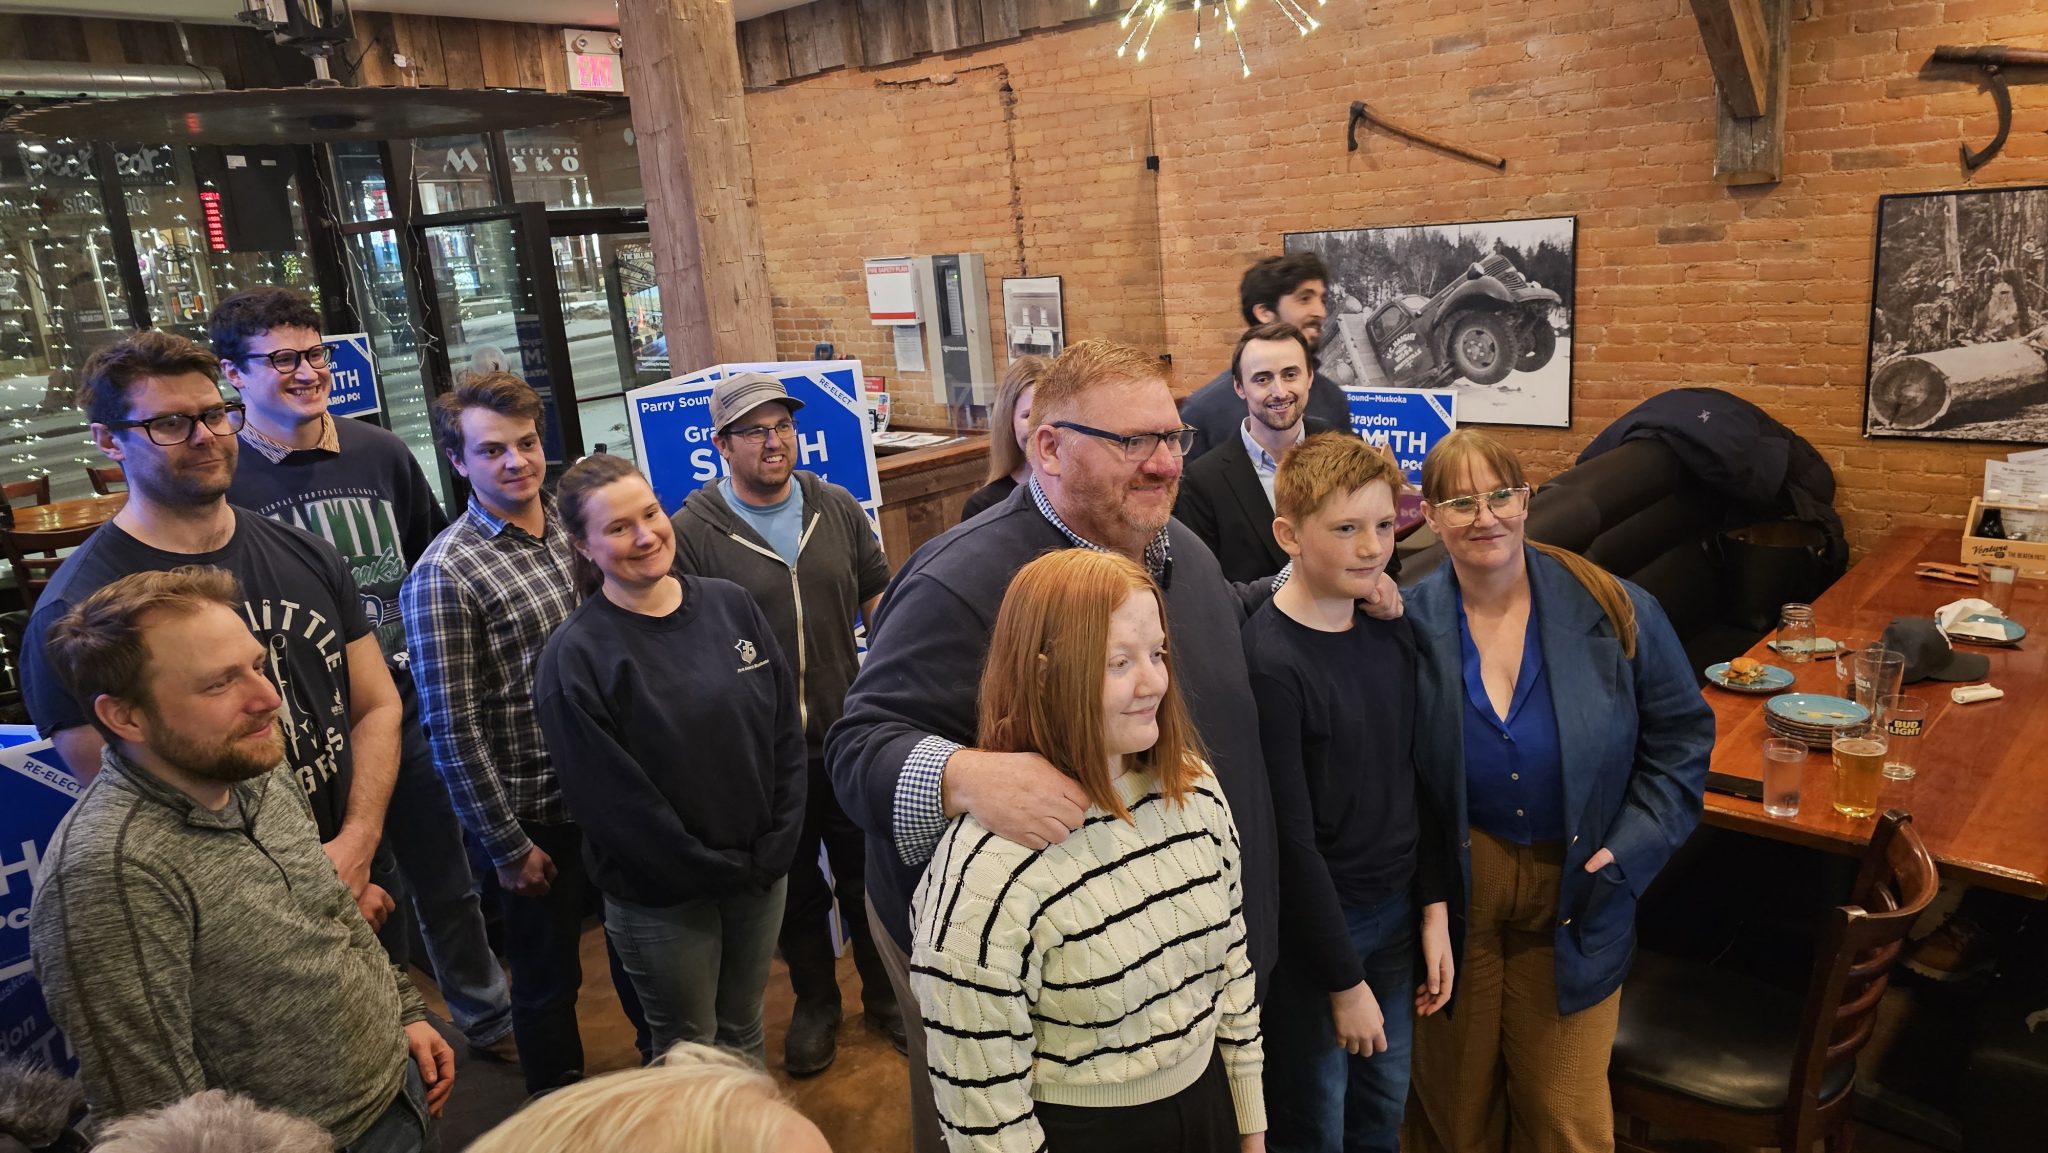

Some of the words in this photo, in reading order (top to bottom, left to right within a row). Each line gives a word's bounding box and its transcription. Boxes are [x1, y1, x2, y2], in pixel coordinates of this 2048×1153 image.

[114, 148, 160, 176] ear
[330, 368, 360, 391] ITH
[327, 394, 346, 406] ARIO
[819, 378, 853, 405] RE-ELECT
[641, 400, 675, 413] Parry
[679, 396, 710, 408] Soun
[259, 498, 293, 515] TIONAL
[298, 488, 343, 501] FOOTBALL
[347, 487, 378, 497] LEAGUE
[1889, 727, 1921, 736] LIGHT
[1894, 720, 1919, 729] BUD
[23, 760, 85, 795] RE-ELECT
